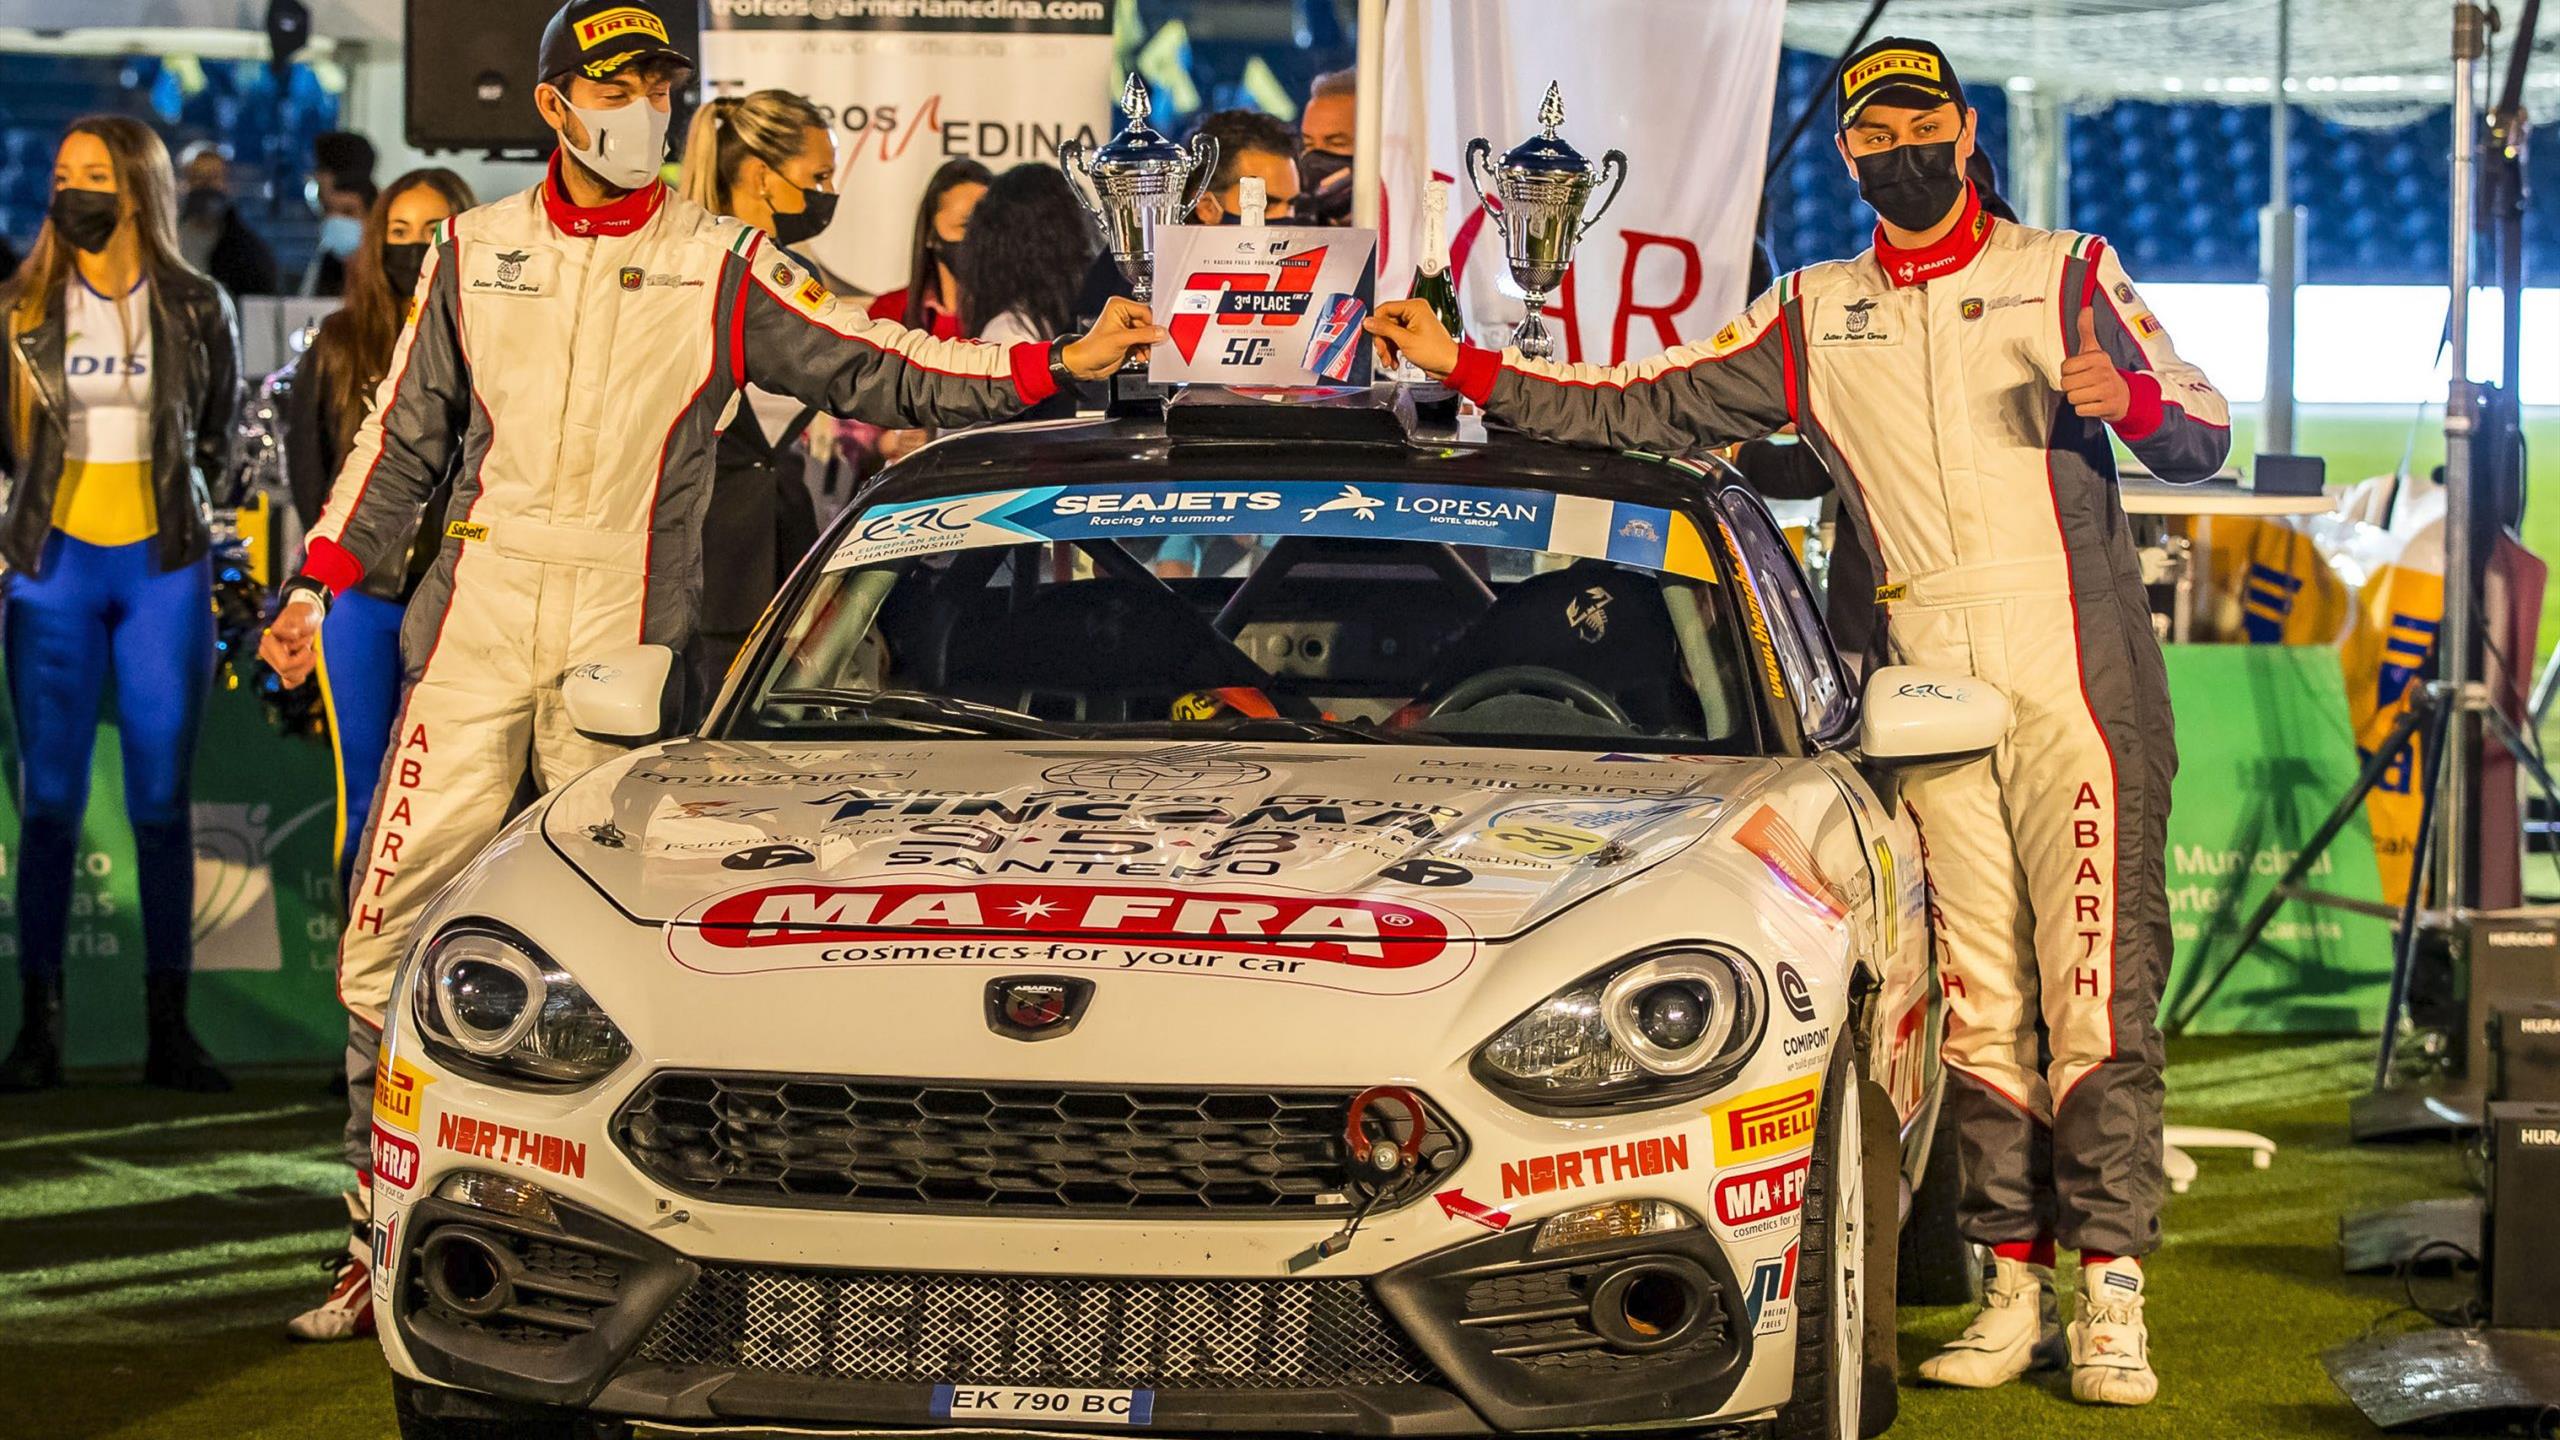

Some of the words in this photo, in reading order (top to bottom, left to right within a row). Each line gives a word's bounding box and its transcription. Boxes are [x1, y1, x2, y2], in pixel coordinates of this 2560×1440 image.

[583, 11, 663, 41] PIRELLI
[1850, 55, 1932, 88] PIRELLI
[1917, 256, 1956, 273] ABARTH
[1234, 294, 1250, 310] 3rd
[1253, 295, 1291, 311] PLACE
[1053, 491, 1282, 515] SEAJETS
[1395, 496, 1538, 523] LOPESAN
[1090, 514, 1145, 528] Racing
[1150, 513, 1167, 524] to
[1171, 514, 1235, 524] summer
[1429, 516, 1463, 527] HOTEL
[1464, 518, 1499, 529] GROUP
[833, 550, 853, 560] FIA
[858, 538, 925, 554] EUROPEAN
[928, 532, 968, 543] RALLY
[854, 539, 965, 562] CHAMPIONSHIP
[1260, 794, 1463, 818] Group
[356, 724, 429, 935] ABARTH
[885, 849, 1281, 879] SANTERO
[2073, 781, 2102, 997] ABARTH
[821, 941, 1038, 962] cosmetics
[1044, 943, 1108, 962] for
[1118, 947, 1216, 969] your
[1239, 954, 1306, 974] car
[1014, 985, 1064, 993] ABARTH
[1783, 1027, 1830, 1057] COMIPONT
[1728, 1089, 1816, 1151] PIRELLI
[438, 1111, 586, 1179] NORTHON
[1501, 1134, 1689, 1199] NORTHON
[1734, 1219, 1778, 1238] cosmetics
[1780, 1214, 1791, 1226] for
[1760, 1319, 1782, 1330] FUELS
[1763, 1306, 1788, 1318] RACING
[952, 1389, 1001, 1410] EK
[1012, 1392, 1070, 1412] 790
[1081, 1394, 1132, 1415] BC
